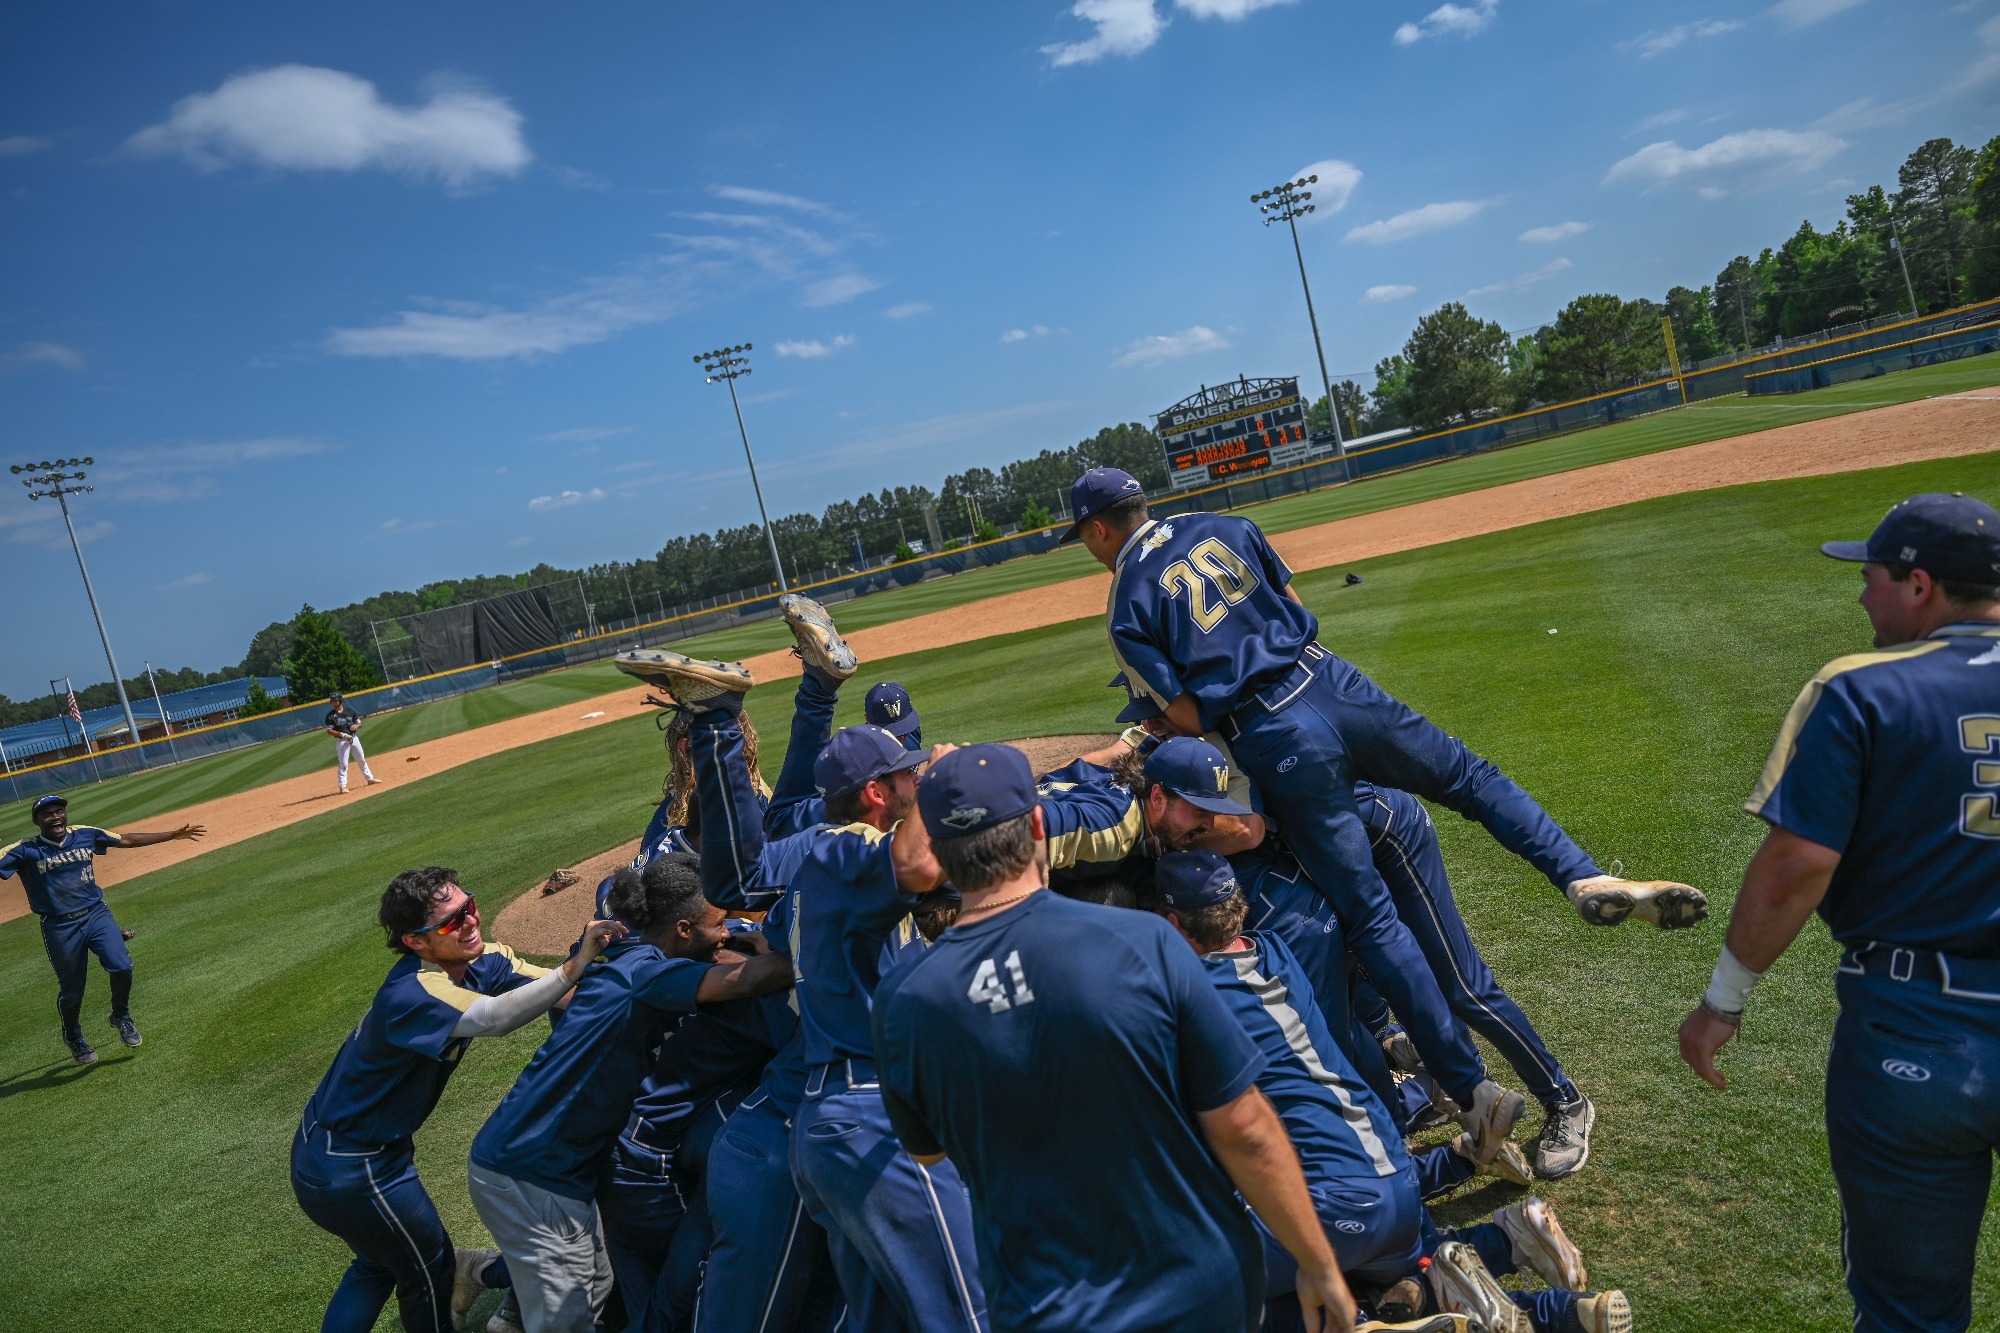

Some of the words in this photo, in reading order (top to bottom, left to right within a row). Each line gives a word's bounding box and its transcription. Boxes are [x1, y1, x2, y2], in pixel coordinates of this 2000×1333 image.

[1166, 425, 1189, 437] JOHN
[1191, 416, 1224, 429] ALDEN
[1225, 398, 1296, 419] SCOREBOARD
[1172, 402, 1230, 426] BAUER
[1232, 389, 1282, 410] FIELD
[1159, 537, 1260, 634] 20
[884, 700, 900, 718] W
[1213, 766, 1228, 792] W
[967, 950, 1035, 1014] 41
